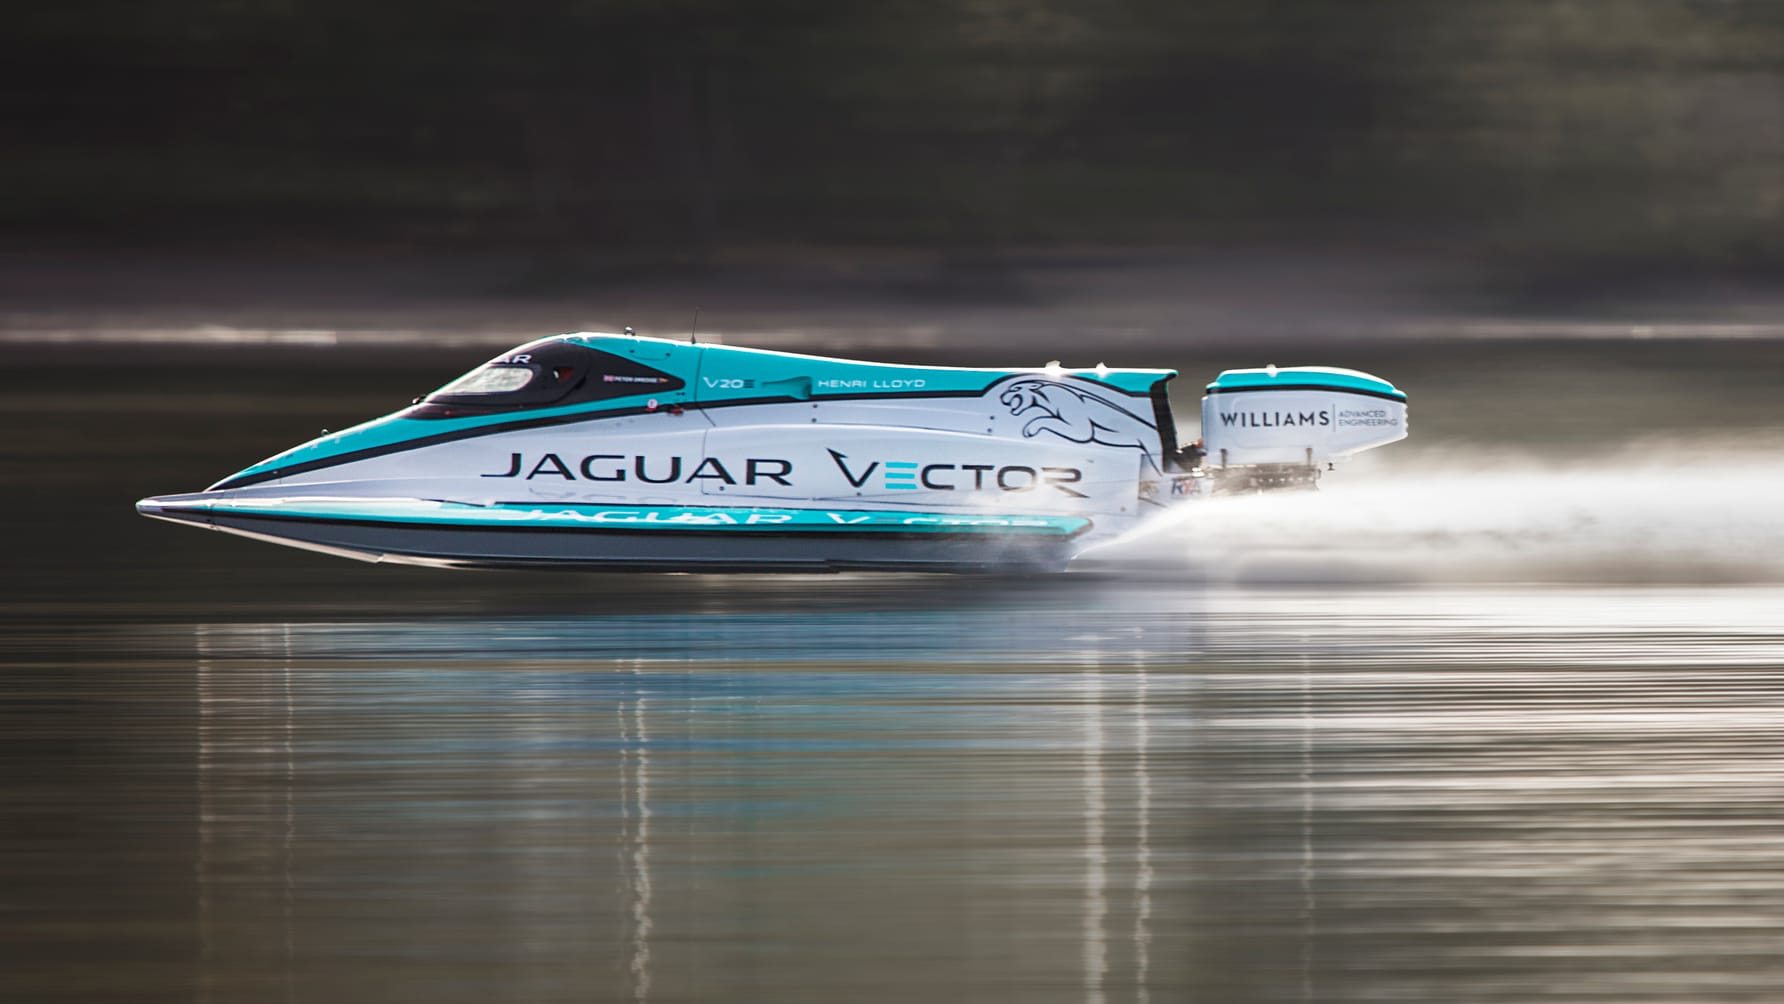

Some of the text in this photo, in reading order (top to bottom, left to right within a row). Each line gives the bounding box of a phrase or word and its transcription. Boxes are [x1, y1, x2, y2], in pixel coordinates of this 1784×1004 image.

[818, 379, 926, 389] HENRI LLOYD
[1338, 410, 1386, 418] ADVANCED
[1220, 411, 1330, 428] WILLIAMS
[1338, 418, 1399, 427] ENGINEERING
[480, 448, 1091, 499] JAGUAR VECTOR
